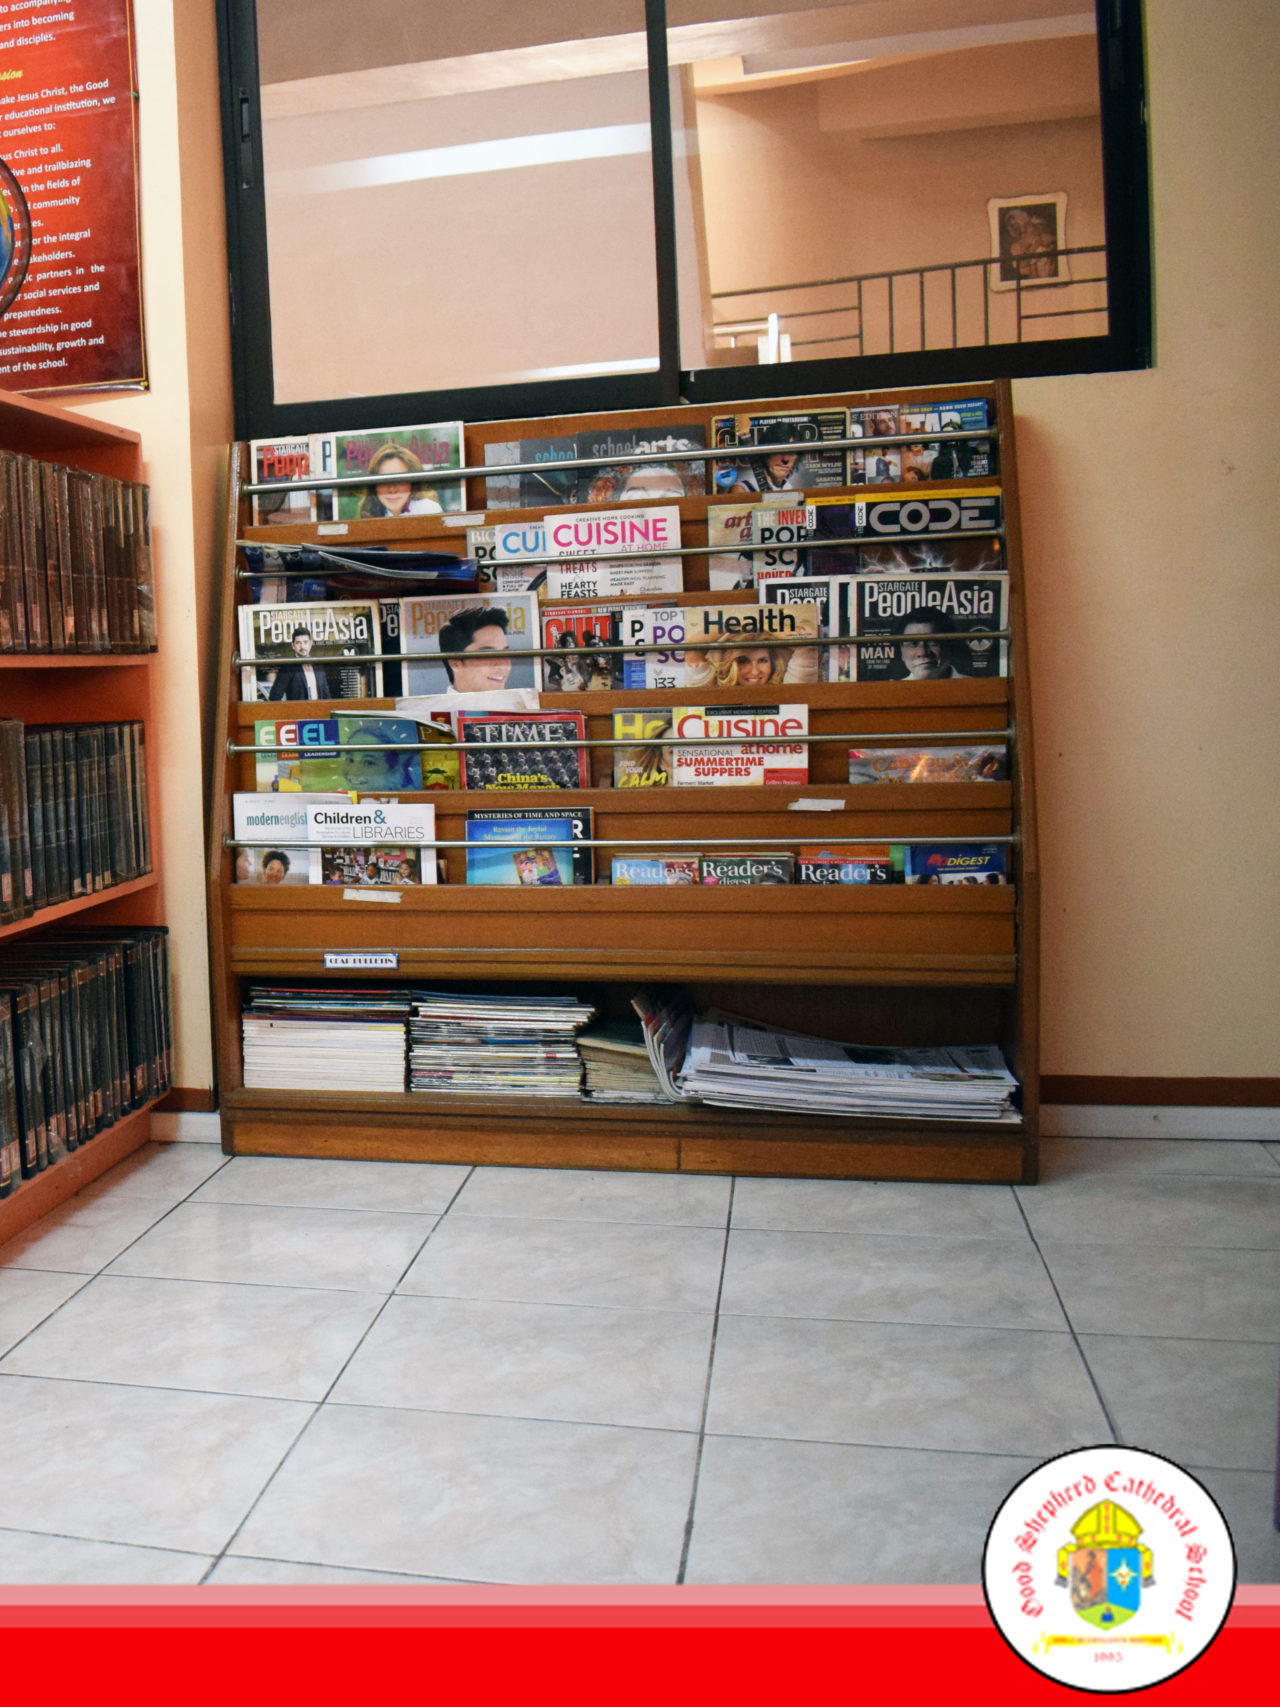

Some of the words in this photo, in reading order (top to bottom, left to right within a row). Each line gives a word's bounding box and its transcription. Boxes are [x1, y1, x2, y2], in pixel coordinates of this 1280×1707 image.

[0, 5, 8, 14] to
[10, 0, 72, 12] accompan
[13, 19, 30, 29] into
[32, 11, 74, 25] becoming
[16, 32, 56, 47] disciples.
[17, 92, 39, 102] Jesus
[40, 87, 68, 98] Christ,
[69, 84, 84, 94] the
[85, 78, 109, 91] Good
[4, 104, 52, 120] educational
[54, 98, 101, 112] institution,
[102, 96, 116, 106] we
[3, 125, 42, 138] ourselves
[44, 122, 56, 132] to:
[14, 148, 38, 160] Christ
[40, 146, 49, 155] to
[50, 144, 64, 154] all.
[26, 164, 42, 175] and
[44, 158, 92, 174] trailblazing
[21, 184, 30, 194] in
[30, 181, 45, 192] the
[46, 178, 70, 190] fields
[71, 176, 82, 187] of
[32, 196, 80, 210] community
[43, 234, 58, 244] the
[58, 229, 92, 243] integral
[29, 250, 76, 264] akeholders.
[36, 269, 72, 282] partners
[76, 266, 85, 276] in
[90, 264, 106, 274] the
[24, 290, 47, 301] social
[48, 286, 82, 298] services
[83, 282, 100, 293] and
[4, 306, 62, 322] preparedness.
[8, 324, 60, 338] stewardship
[60, 321, 69, 331] in
[70, 318, 92, 332] good
[56, 336, 87, 352] growth
[88, 335, 105, 346] and
[12, 362, 21, 374] of
[22, 361, 37, 372] the
[38, 358, 68, 370] school.
[756, 511, 776, 526] THE
[870, 498, 996, 533] CODE
[553, 518, 668, 548] CUISINE
[621, 544, 632, 553] AT
[636, 542, 668, 552] HOME
[558, 562, 598, 574] TREATS
[560, 581, 598, 590] HEARTY
[560, 589, 598, 598] FEASTS
[789, 588, 828, 598] STARGATE
[878, 582, 920, 592] STARGATE
[864, 581, 994, 618] PeopleAsia
[652, 610, 670, 622] TOP
[704, 608, 797, 636] Health
[860, 646, 895, 660] MAN
[677, 714, 803, 739] Cuisine
[676, 757, 764, 766] SUMMERTIME
[497, 772, 548, 784] China's
[618, 771, 668, 788] CALM
[694, 767, 751, 777] SUPPERS
[314, 812, 372, 824] Children
[374, 810, 386, 824] &
[352, 826, 424, 840] LIBRARIES
[616, 863, 694, 878] Reader's
[702, 861, 783, 877] Reader's
[800, 864, 886, 881] Reader's
